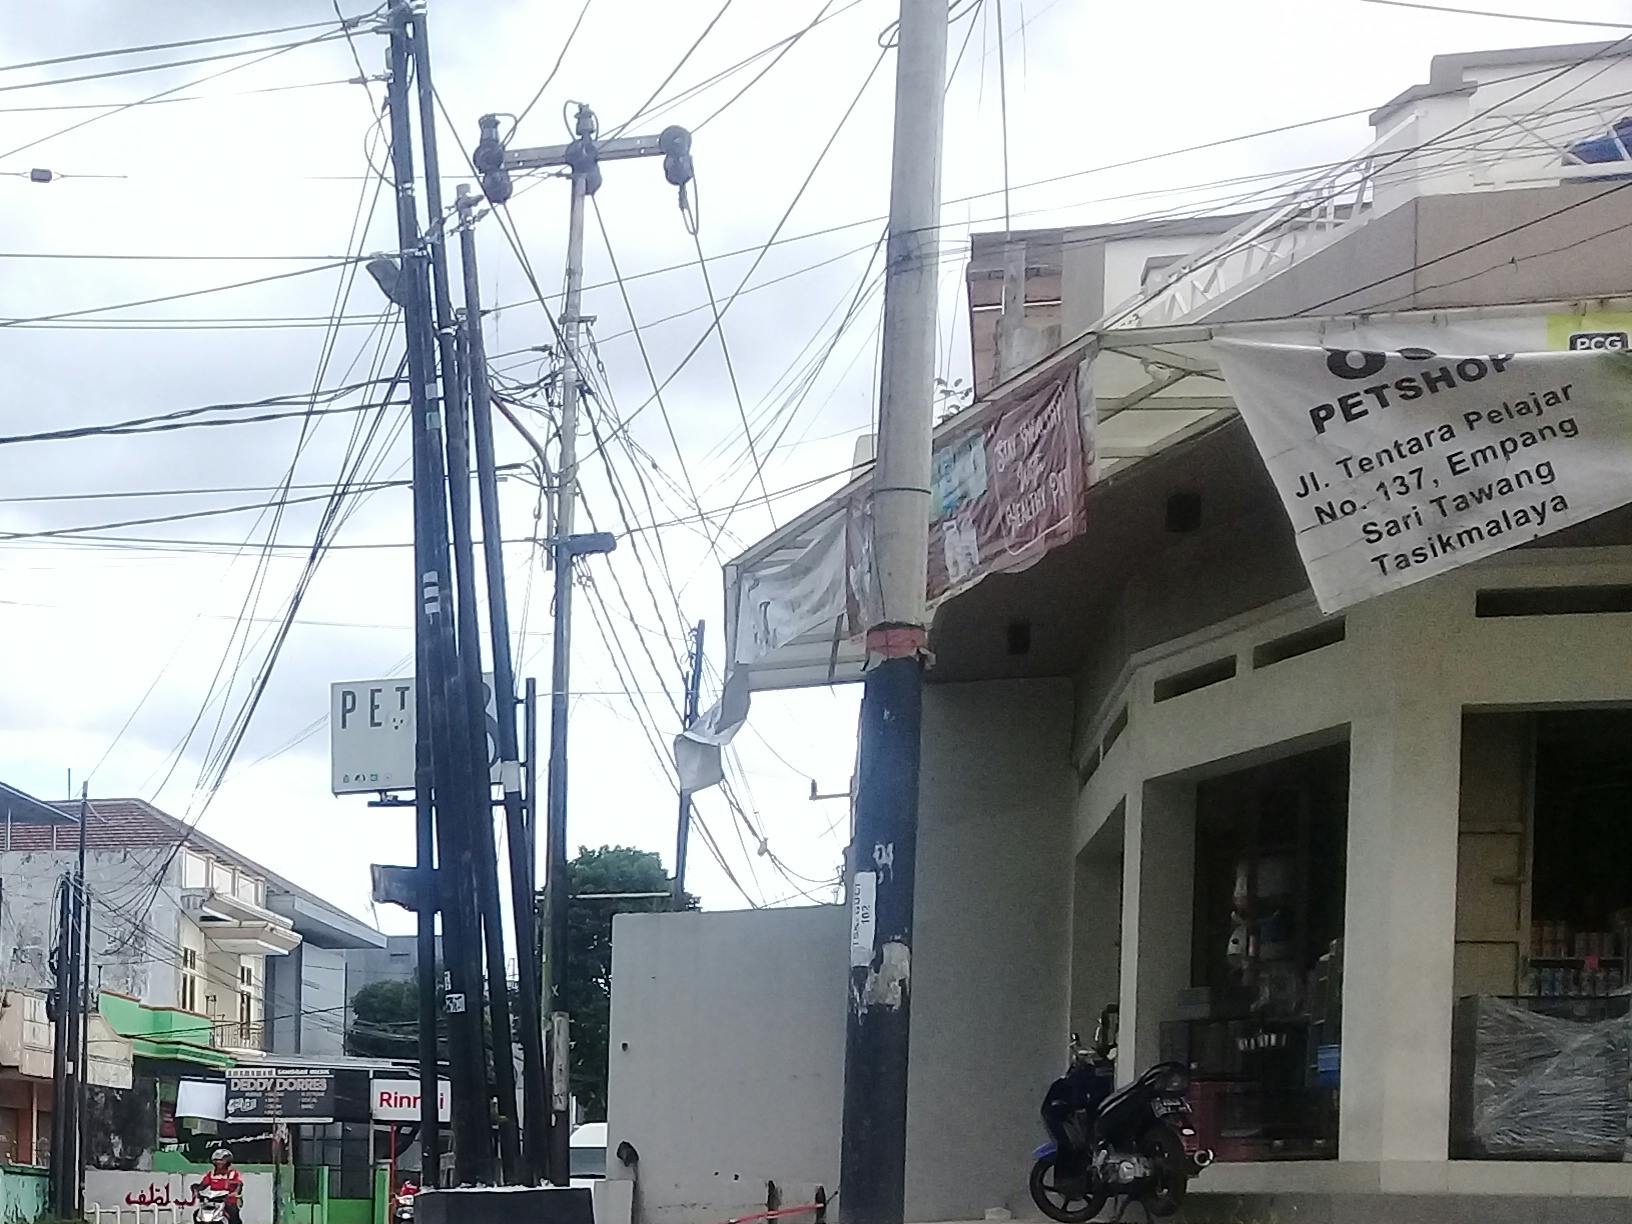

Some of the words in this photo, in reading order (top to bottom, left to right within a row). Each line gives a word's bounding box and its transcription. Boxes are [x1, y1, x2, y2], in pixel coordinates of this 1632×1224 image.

[1314, 498, 1368, 525] No.
[1376, 467, 1440, 502] 137,
[1447, 416, 1580, 476] Empang
[1336, 423, 1456, 480] Tentara
[1463, 383, 1574, 431] Pelajar
[1362, 506, 1424, 544] Sari
[1429, 459, 1556, 518] Tawang
[1371, 491, 1569, 576] Tasikmalaya
[231, 1079, 274, 1091] DEDDY
[379, 1091, 445, 1109] Rinni
